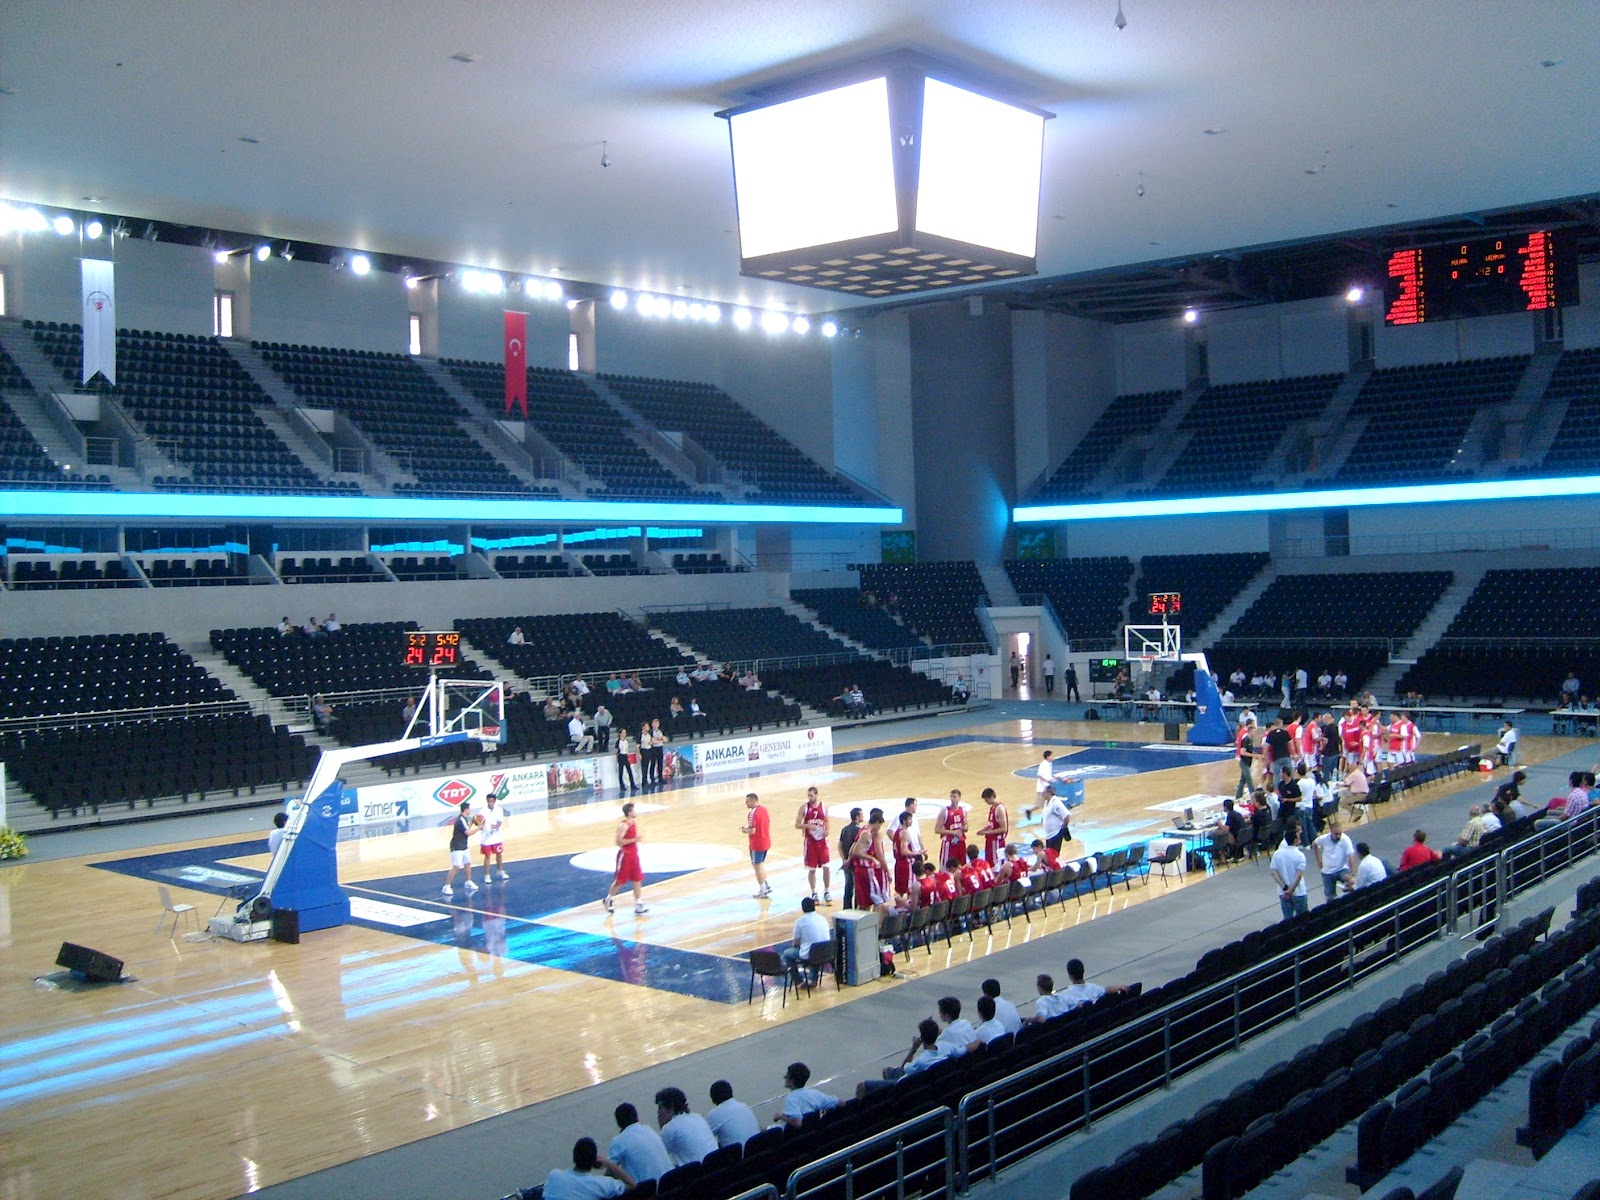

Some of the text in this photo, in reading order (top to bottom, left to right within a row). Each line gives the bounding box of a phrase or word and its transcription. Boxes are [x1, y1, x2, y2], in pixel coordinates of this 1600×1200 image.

[1461, 245, 1467, 255] 0
[1495, 241, 1502, 250] 0
[1452, 270, 1458, 279] 0
[1497, 265, 1504, 273] 0
[1152, 602, 1166, 613] 24
[406, 647, 423, 664] 24
[433, 647, 455, 664] 24
[760, 740, 791, 752] GENERALI
[705, 745, 745, 761] ANKARA
[512, 771, 545, 782] ANKARA
[442, 787, 467, 799] TRT
[364, 802, 395, 818] zimer
[980, 867, 995, 882] 11
[945, 880, 956, 893] 6
[970, 874, 979, 889] 5
